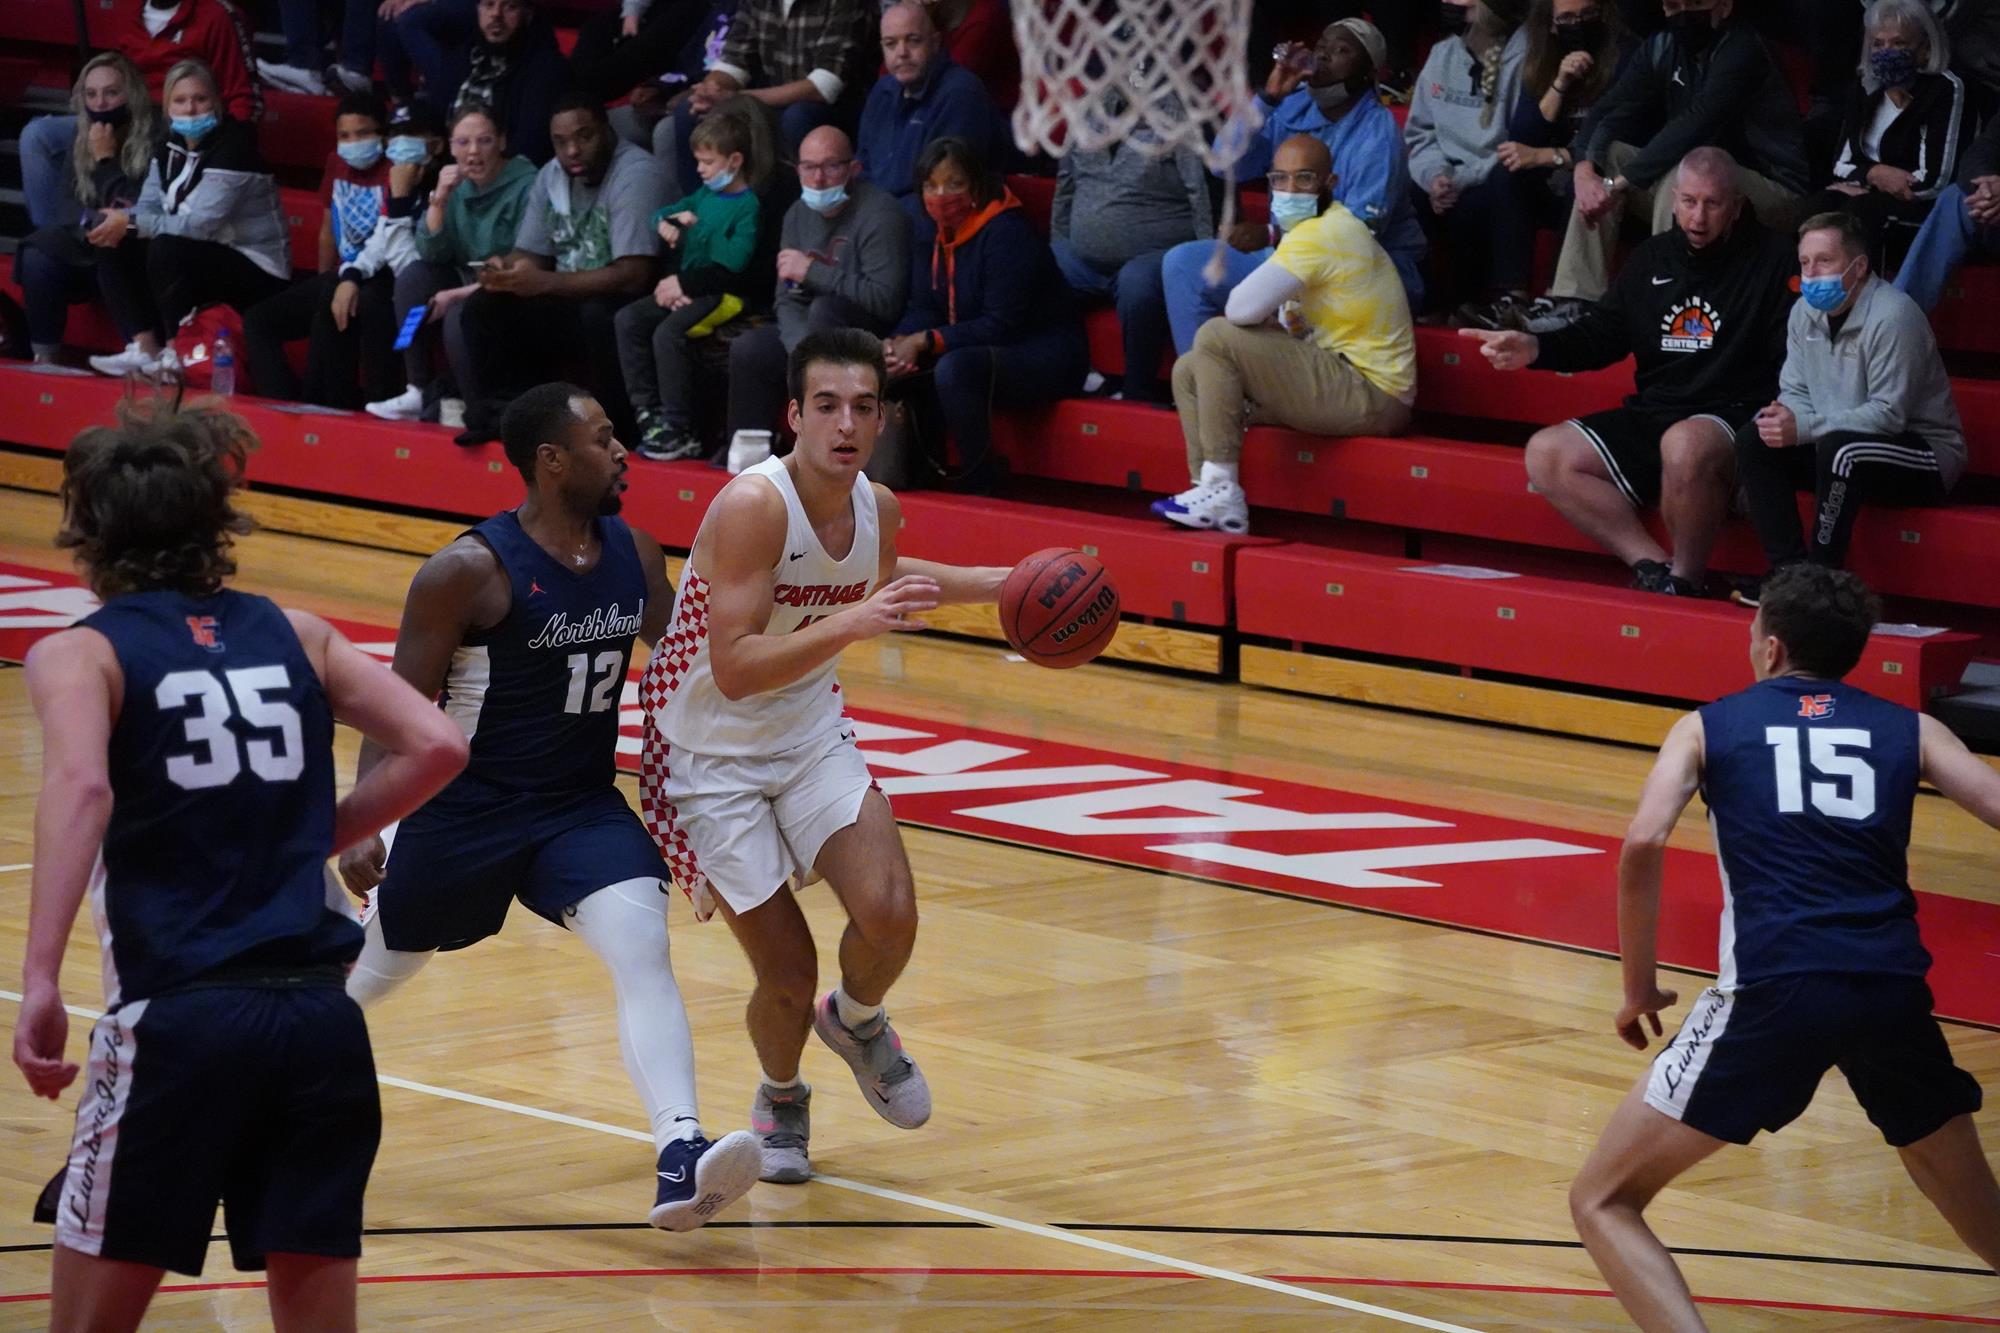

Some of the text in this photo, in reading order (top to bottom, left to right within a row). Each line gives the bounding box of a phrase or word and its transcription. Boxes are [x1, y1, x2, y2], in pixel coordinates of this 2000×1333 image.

[1817, 481, 1847, 545] adidas
[1038, 562, 1087, 609] NCAA
[1050, 585, 1115, 644] Wilson
[528, 598, 644, 649] Northland
[564, 650, 624, 714] 12
[155, 664, 305, 791] 35
[1765, 726, 1876, 821] 15
